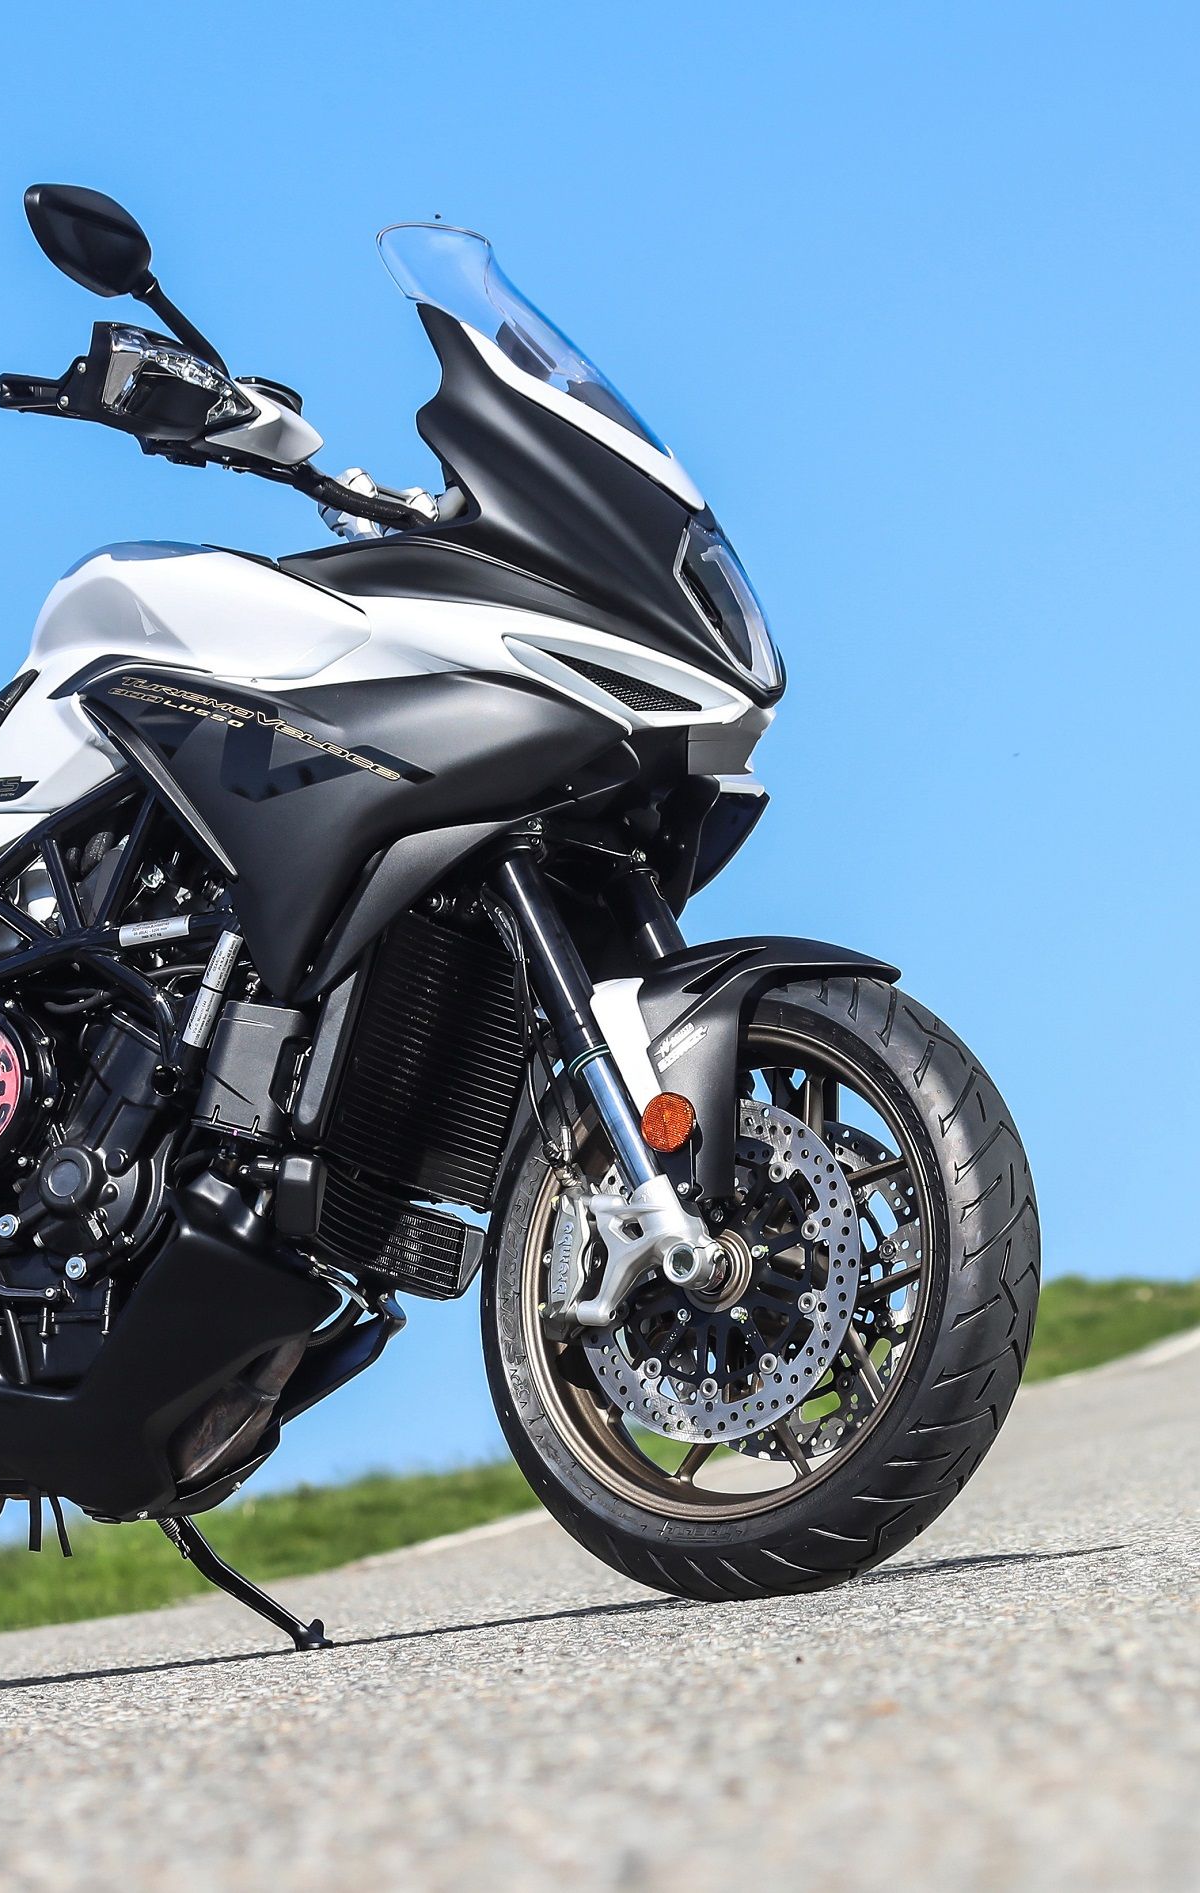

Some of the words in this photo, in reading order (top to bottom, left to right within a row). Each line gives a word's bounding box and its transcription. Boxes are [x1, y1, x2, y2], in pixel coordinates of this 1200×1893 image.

[163, 700, 245, 728] LUSSO
[257, 711, 400, 780] VELOCE
[552, 1221, 574, 1296] brembo
